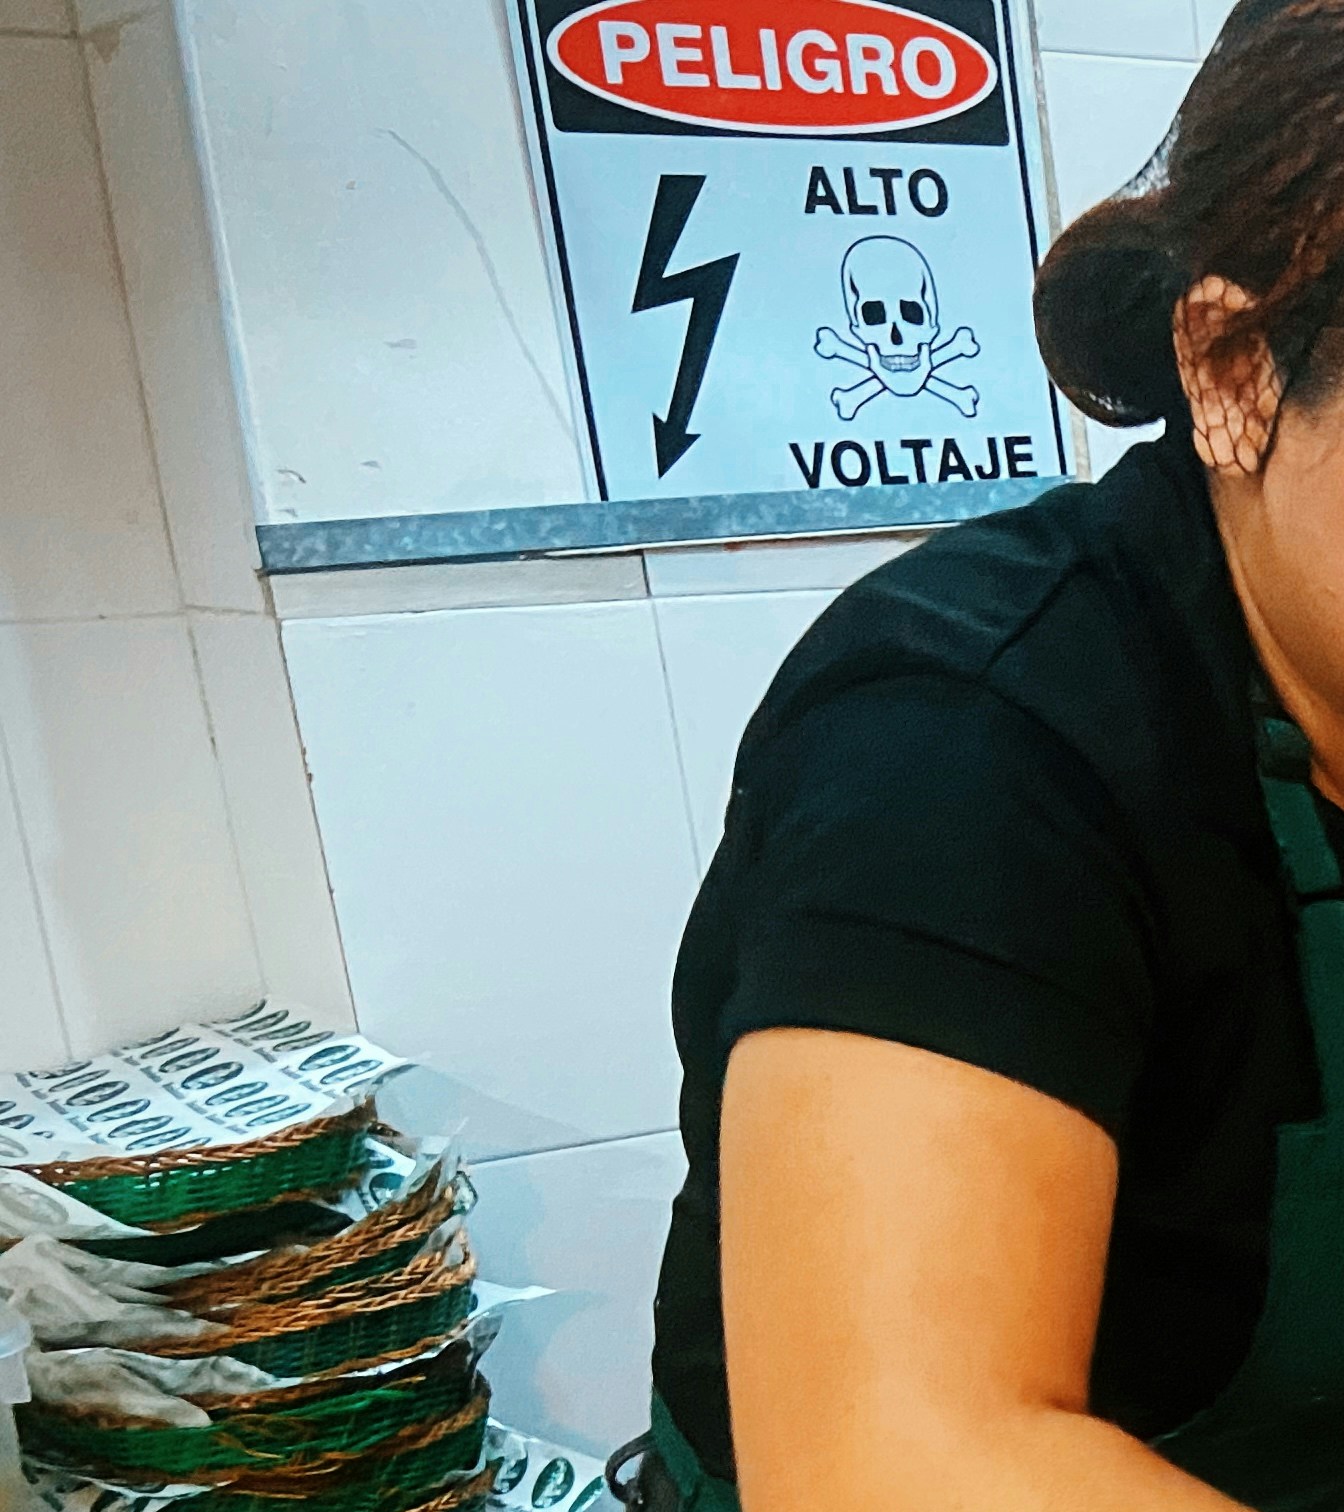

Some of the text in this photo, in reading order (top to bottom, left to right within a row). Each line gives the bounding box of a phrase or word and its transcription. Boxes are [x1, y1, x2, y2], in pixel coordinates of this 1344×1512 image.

[598, 20, 957, 100] PELIGRO
[804, 166, 949, 218] ALTO
[788, 435, 1038, 489] VOLTAJE
